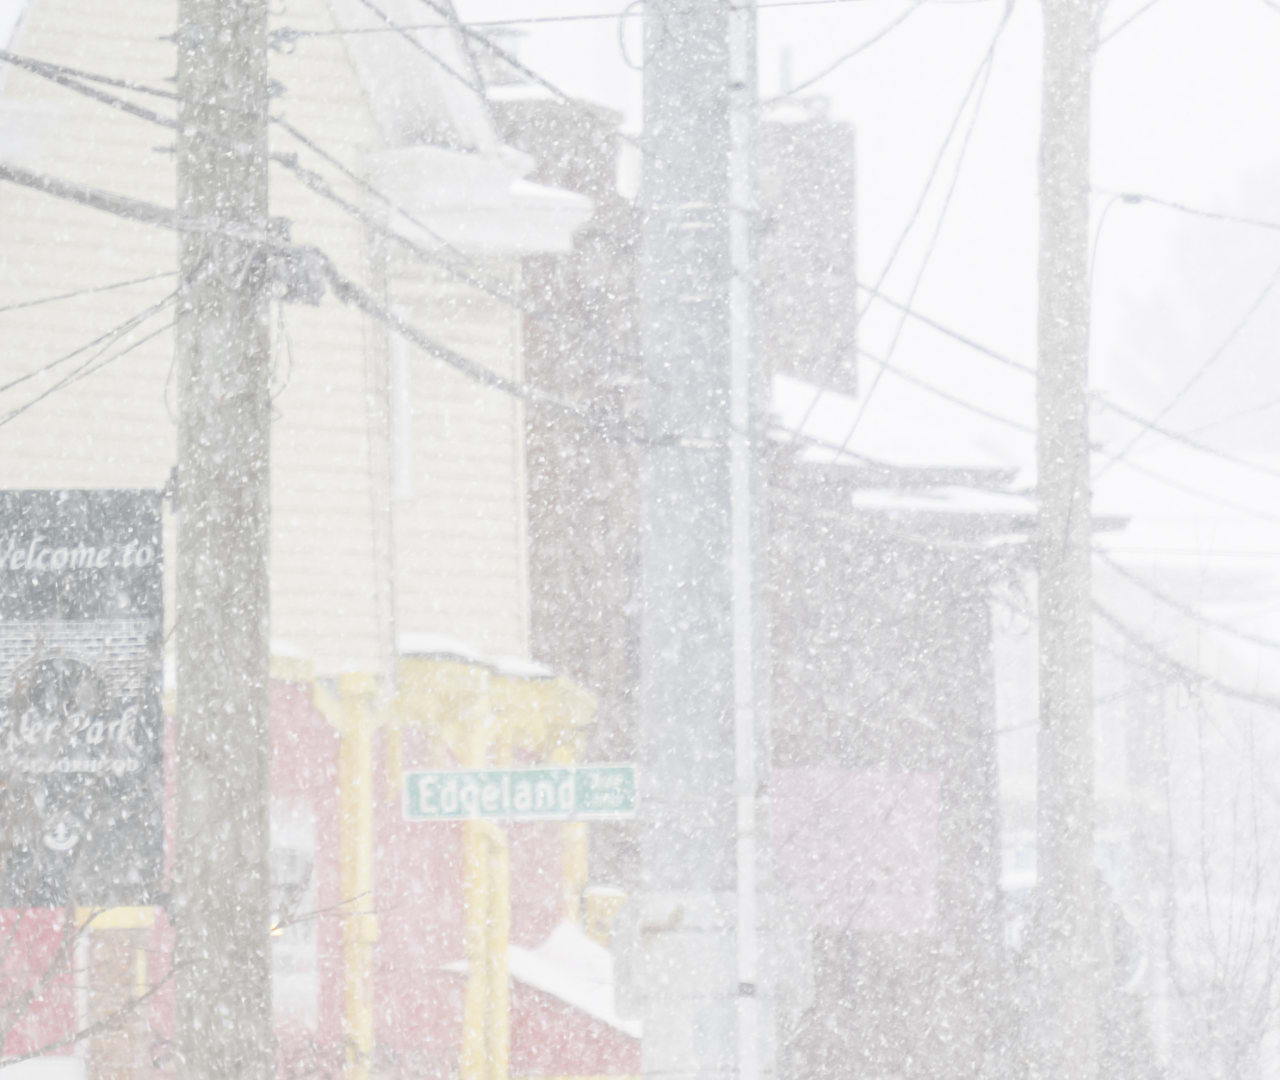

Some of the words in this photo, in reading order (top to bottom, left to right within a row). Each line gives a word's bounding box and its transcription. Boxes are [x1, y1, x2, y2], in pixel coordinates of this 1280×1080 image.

[0, 533, 111, 570] elcome
[122, 538, 153, 569] to
[418, 773, 575, 816] Edgeland
